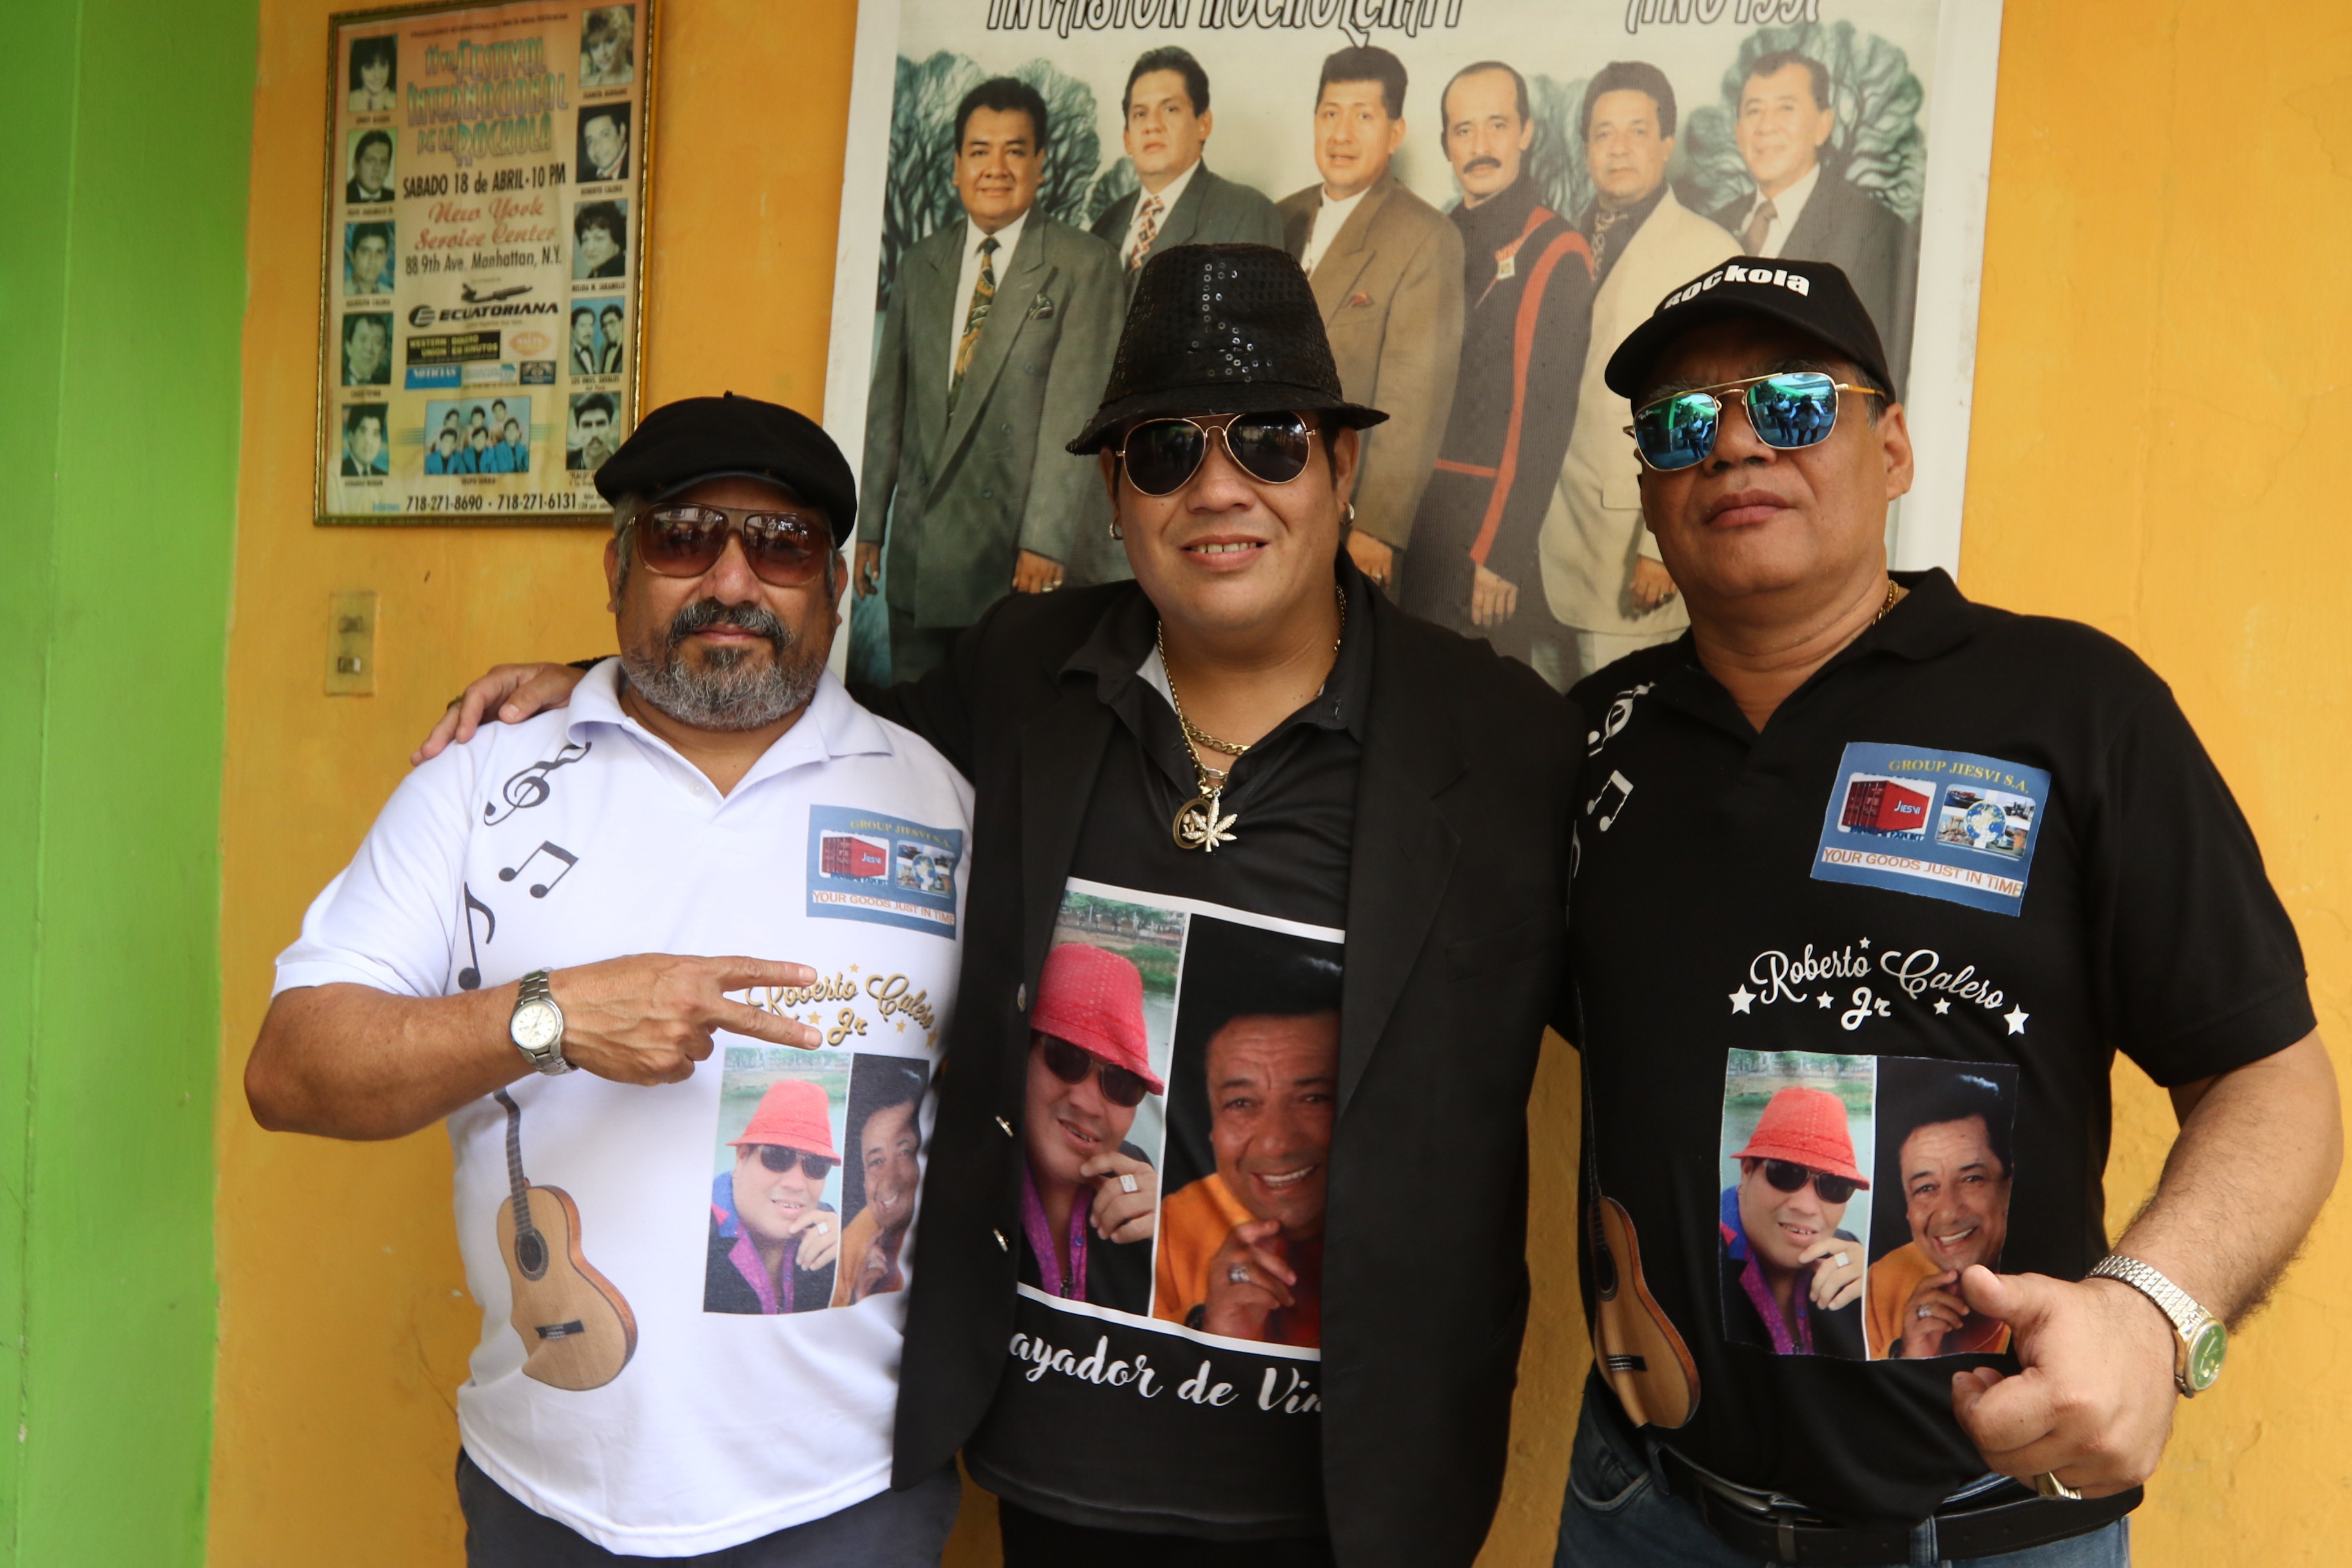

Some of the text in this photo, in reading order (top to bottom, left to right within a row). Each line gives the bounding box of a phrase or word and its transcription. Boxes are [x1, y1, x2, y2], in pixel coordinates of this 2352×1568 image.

[407, 73, 568, 126] INTERNACIONAL
[453, 112, 551, 167] ROCKOLA
[403, 173, 448, 199] SABADO
[455, 172, 469, 193] 18
[475, 170, 488, 193] de
[549, 162, 565, 186] PM
[428, 195, 544, 223] New York
[415, 222, 557, 251] Service Center
[406, 255, 418, 275] 88
[422, 252, 440, 273] 9th
[438, 302, 559, 321] ECUATORIANA
[409, 334, 480, 349] WESTERN DINERO
[421, 347, 447, 358] UNION
[464, 342, 498, 353] MINUTOS
[406, 495, 483, 512] 718-271-8690
[498, 493, 576, 510] 718-271-6131
[1888, 759, 2029, 794] GROUP JIESVI S.A.
[850, 819, 892, 832] GROUP
[1823, 848, 2024, 897] YOUR GOODS JUST IN TIME
[813, 890, 955, 926] YOUR GOODS JUST IN TIME
[1750, 943, 2003, 1009] Roberto Calero
[1841, 986, 1892, 1031] Jr
[827, 1007, 867, 1046] Jr
[1177, 1360, 1239, 1407] de
